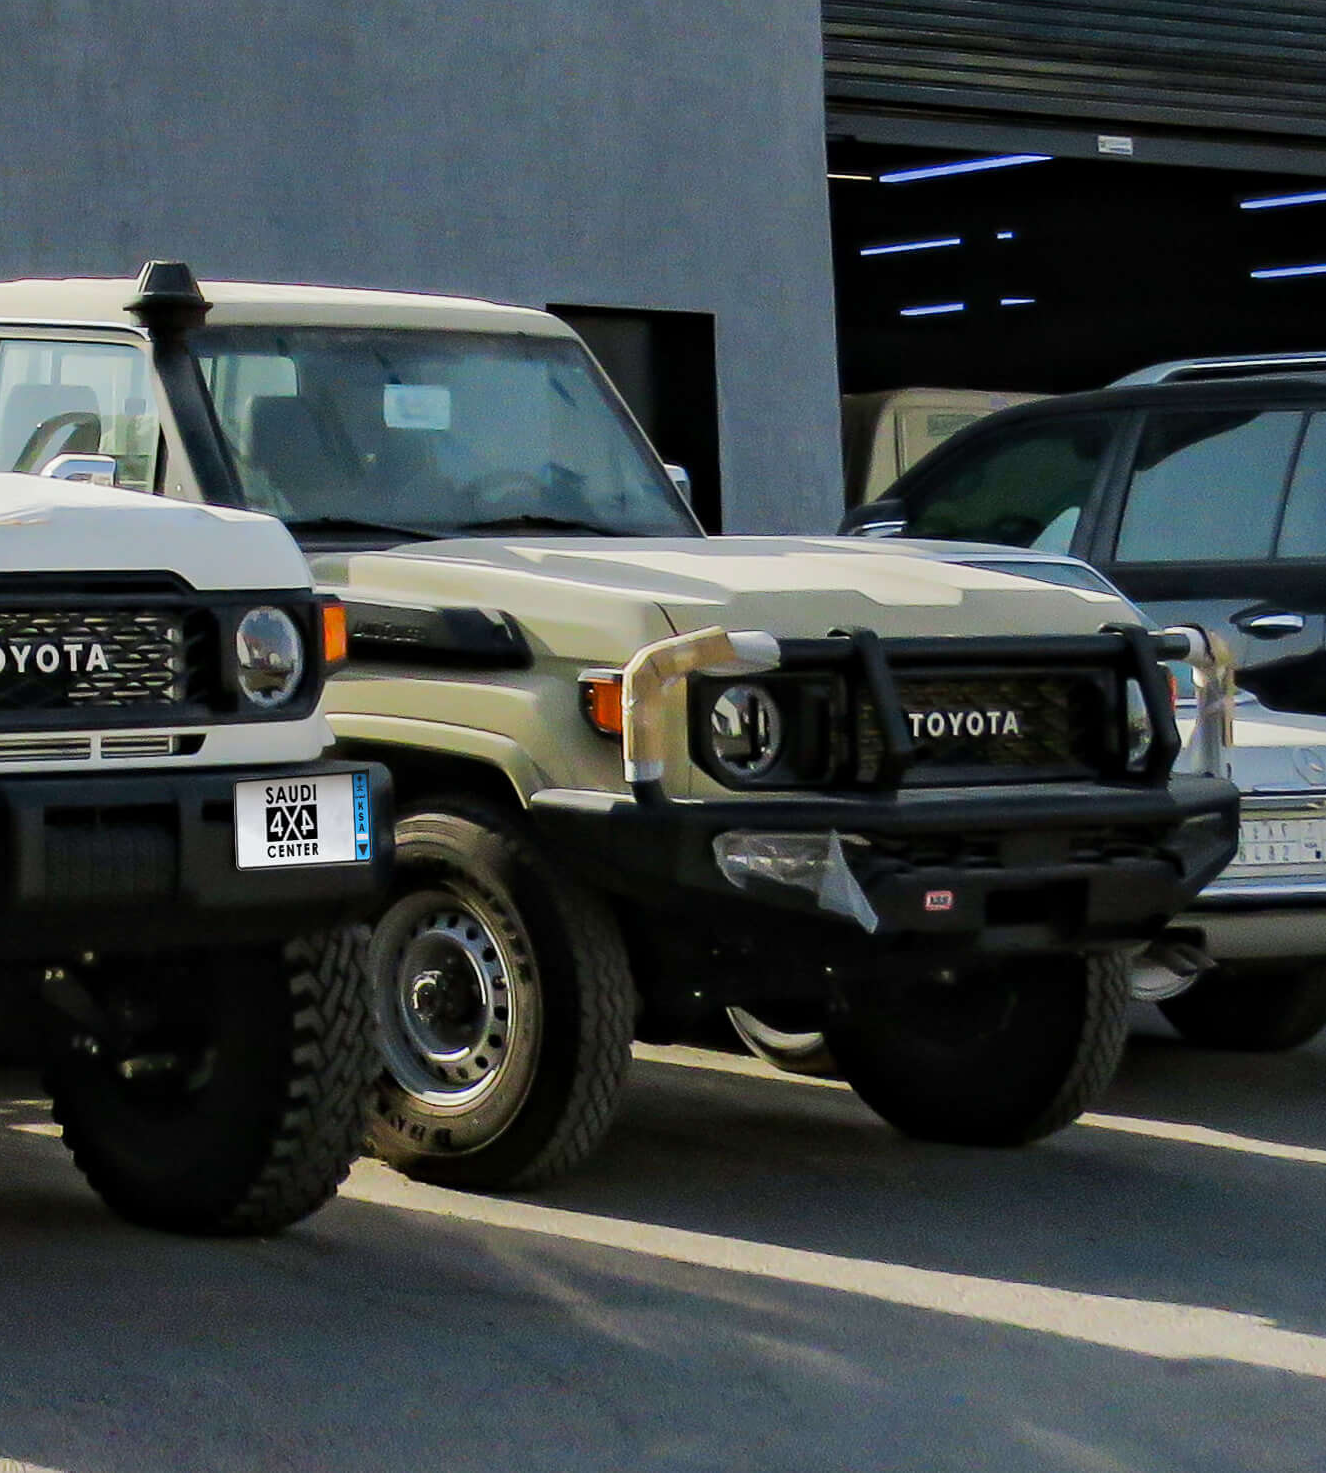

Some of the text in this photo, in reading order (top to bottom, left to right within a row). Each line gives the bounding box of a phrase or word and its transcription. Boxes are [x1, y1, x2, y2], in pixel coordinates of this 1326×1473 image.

[908, 711, 1019, 737] TOYOTA
[265, 784, 317, 804] SAUDI
[267, 842, 319, 858] CENTER
